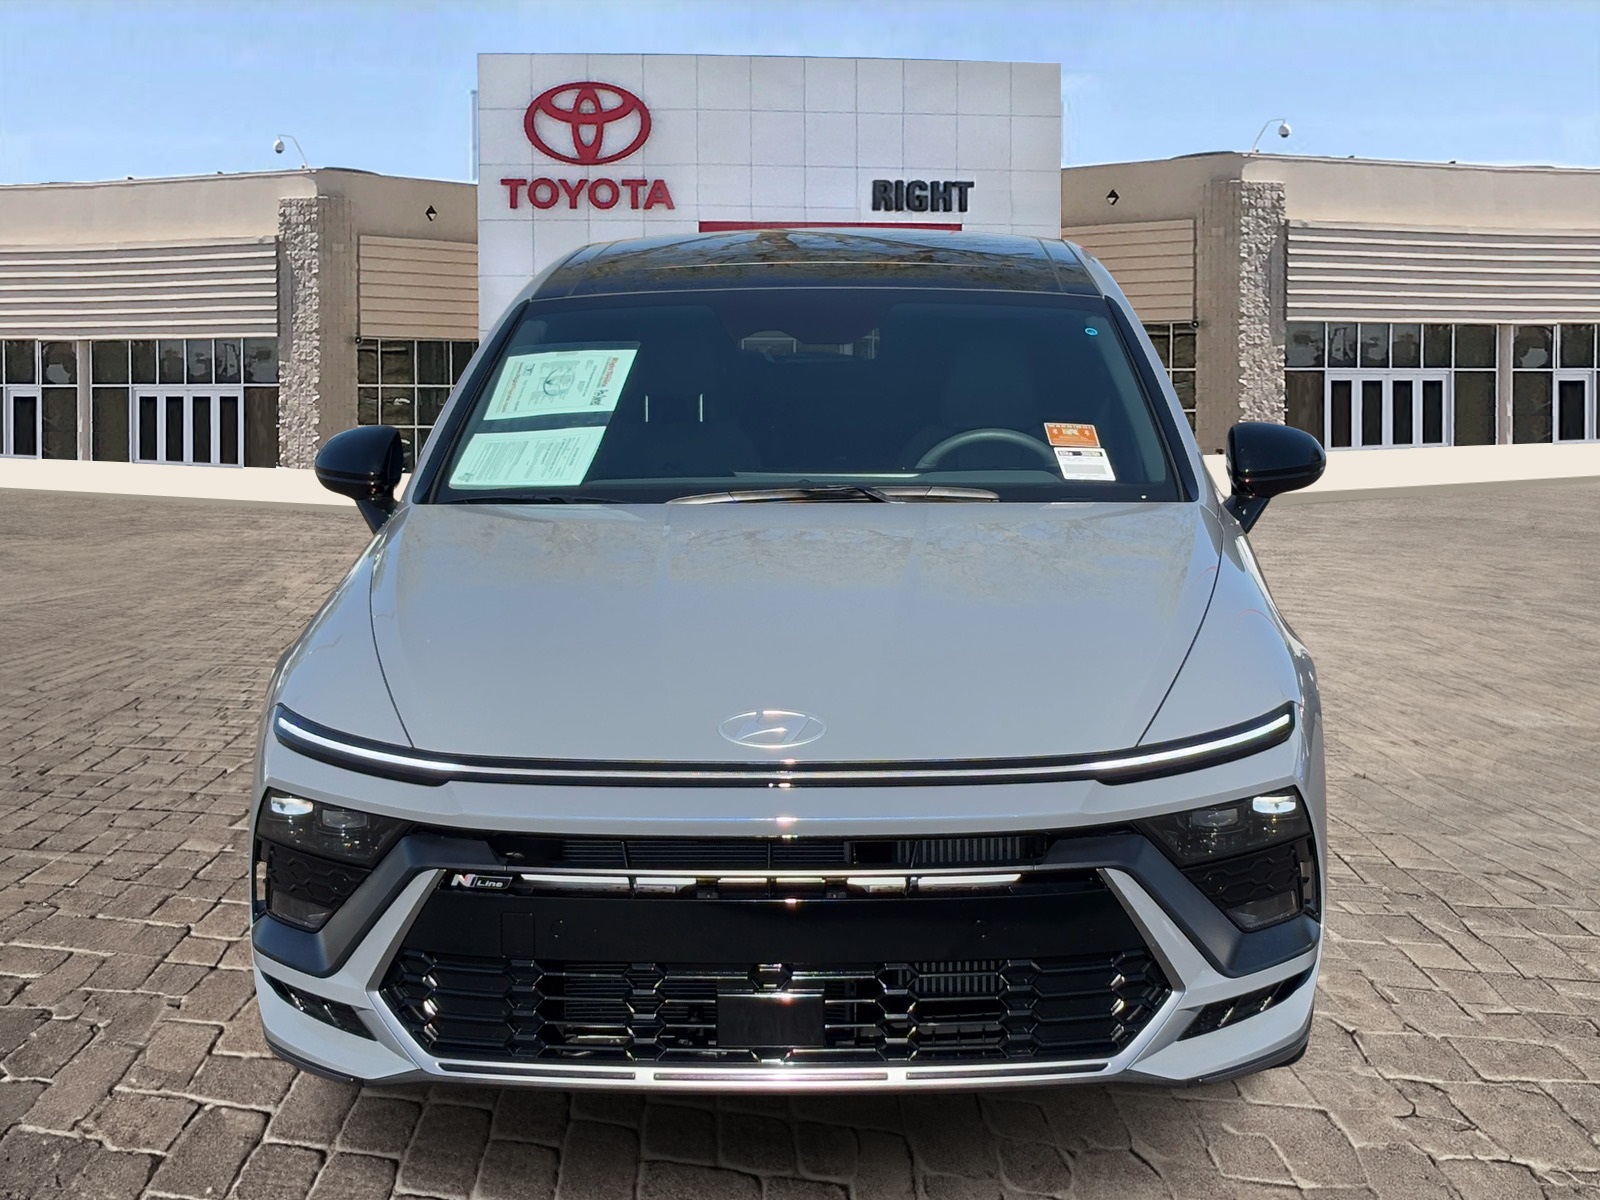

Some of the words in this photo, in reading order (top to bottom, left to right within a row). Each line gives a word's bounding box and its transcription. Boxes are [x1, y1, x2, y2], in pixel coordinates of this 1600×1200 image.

[500, 177, 675, 210] TOYOTA
[872, 179, 975, 212] RIGHT
[451, 873, 476, 888] N
[476, 880, 504, 888] Line
